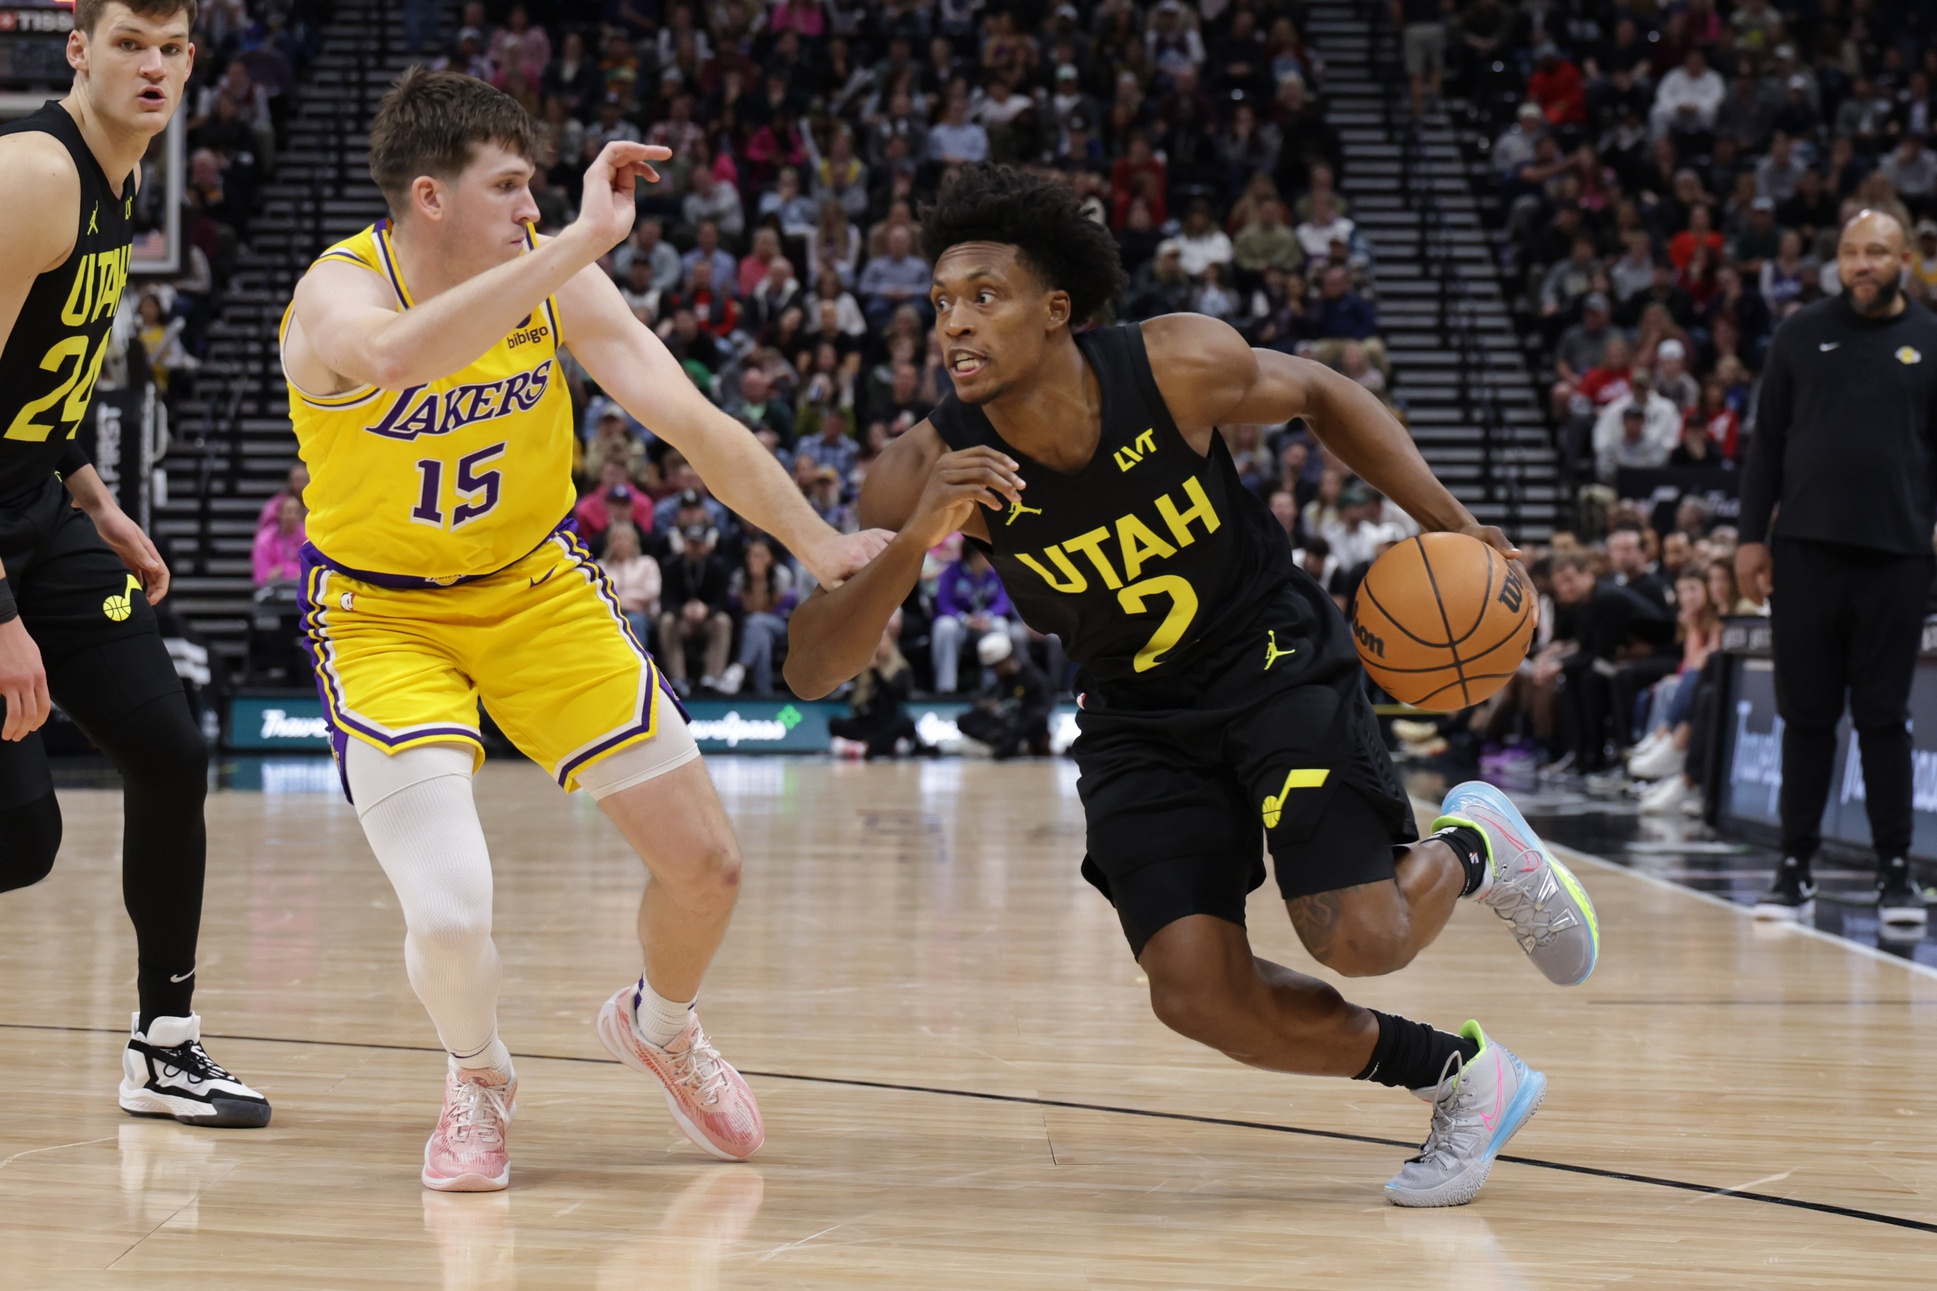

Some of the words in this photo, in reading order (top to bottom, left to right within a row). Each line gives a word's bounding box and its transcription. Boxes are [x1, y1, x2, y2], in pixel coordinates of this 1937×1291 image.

[17, 10, 75, 32] TISS
[61, 243, 133, 327] UTAH
[507, 326, 549, 349] bibigo
[3, 326, 112, 442] 24
[363, 358, 554, 442] LAKERS
[409, 440, 508, 533] 15
[1113, 428, 1157, 472] LVT
[1014, 475, 1221, 594] UTAH
[1117, 574, 1199, 673] 2
